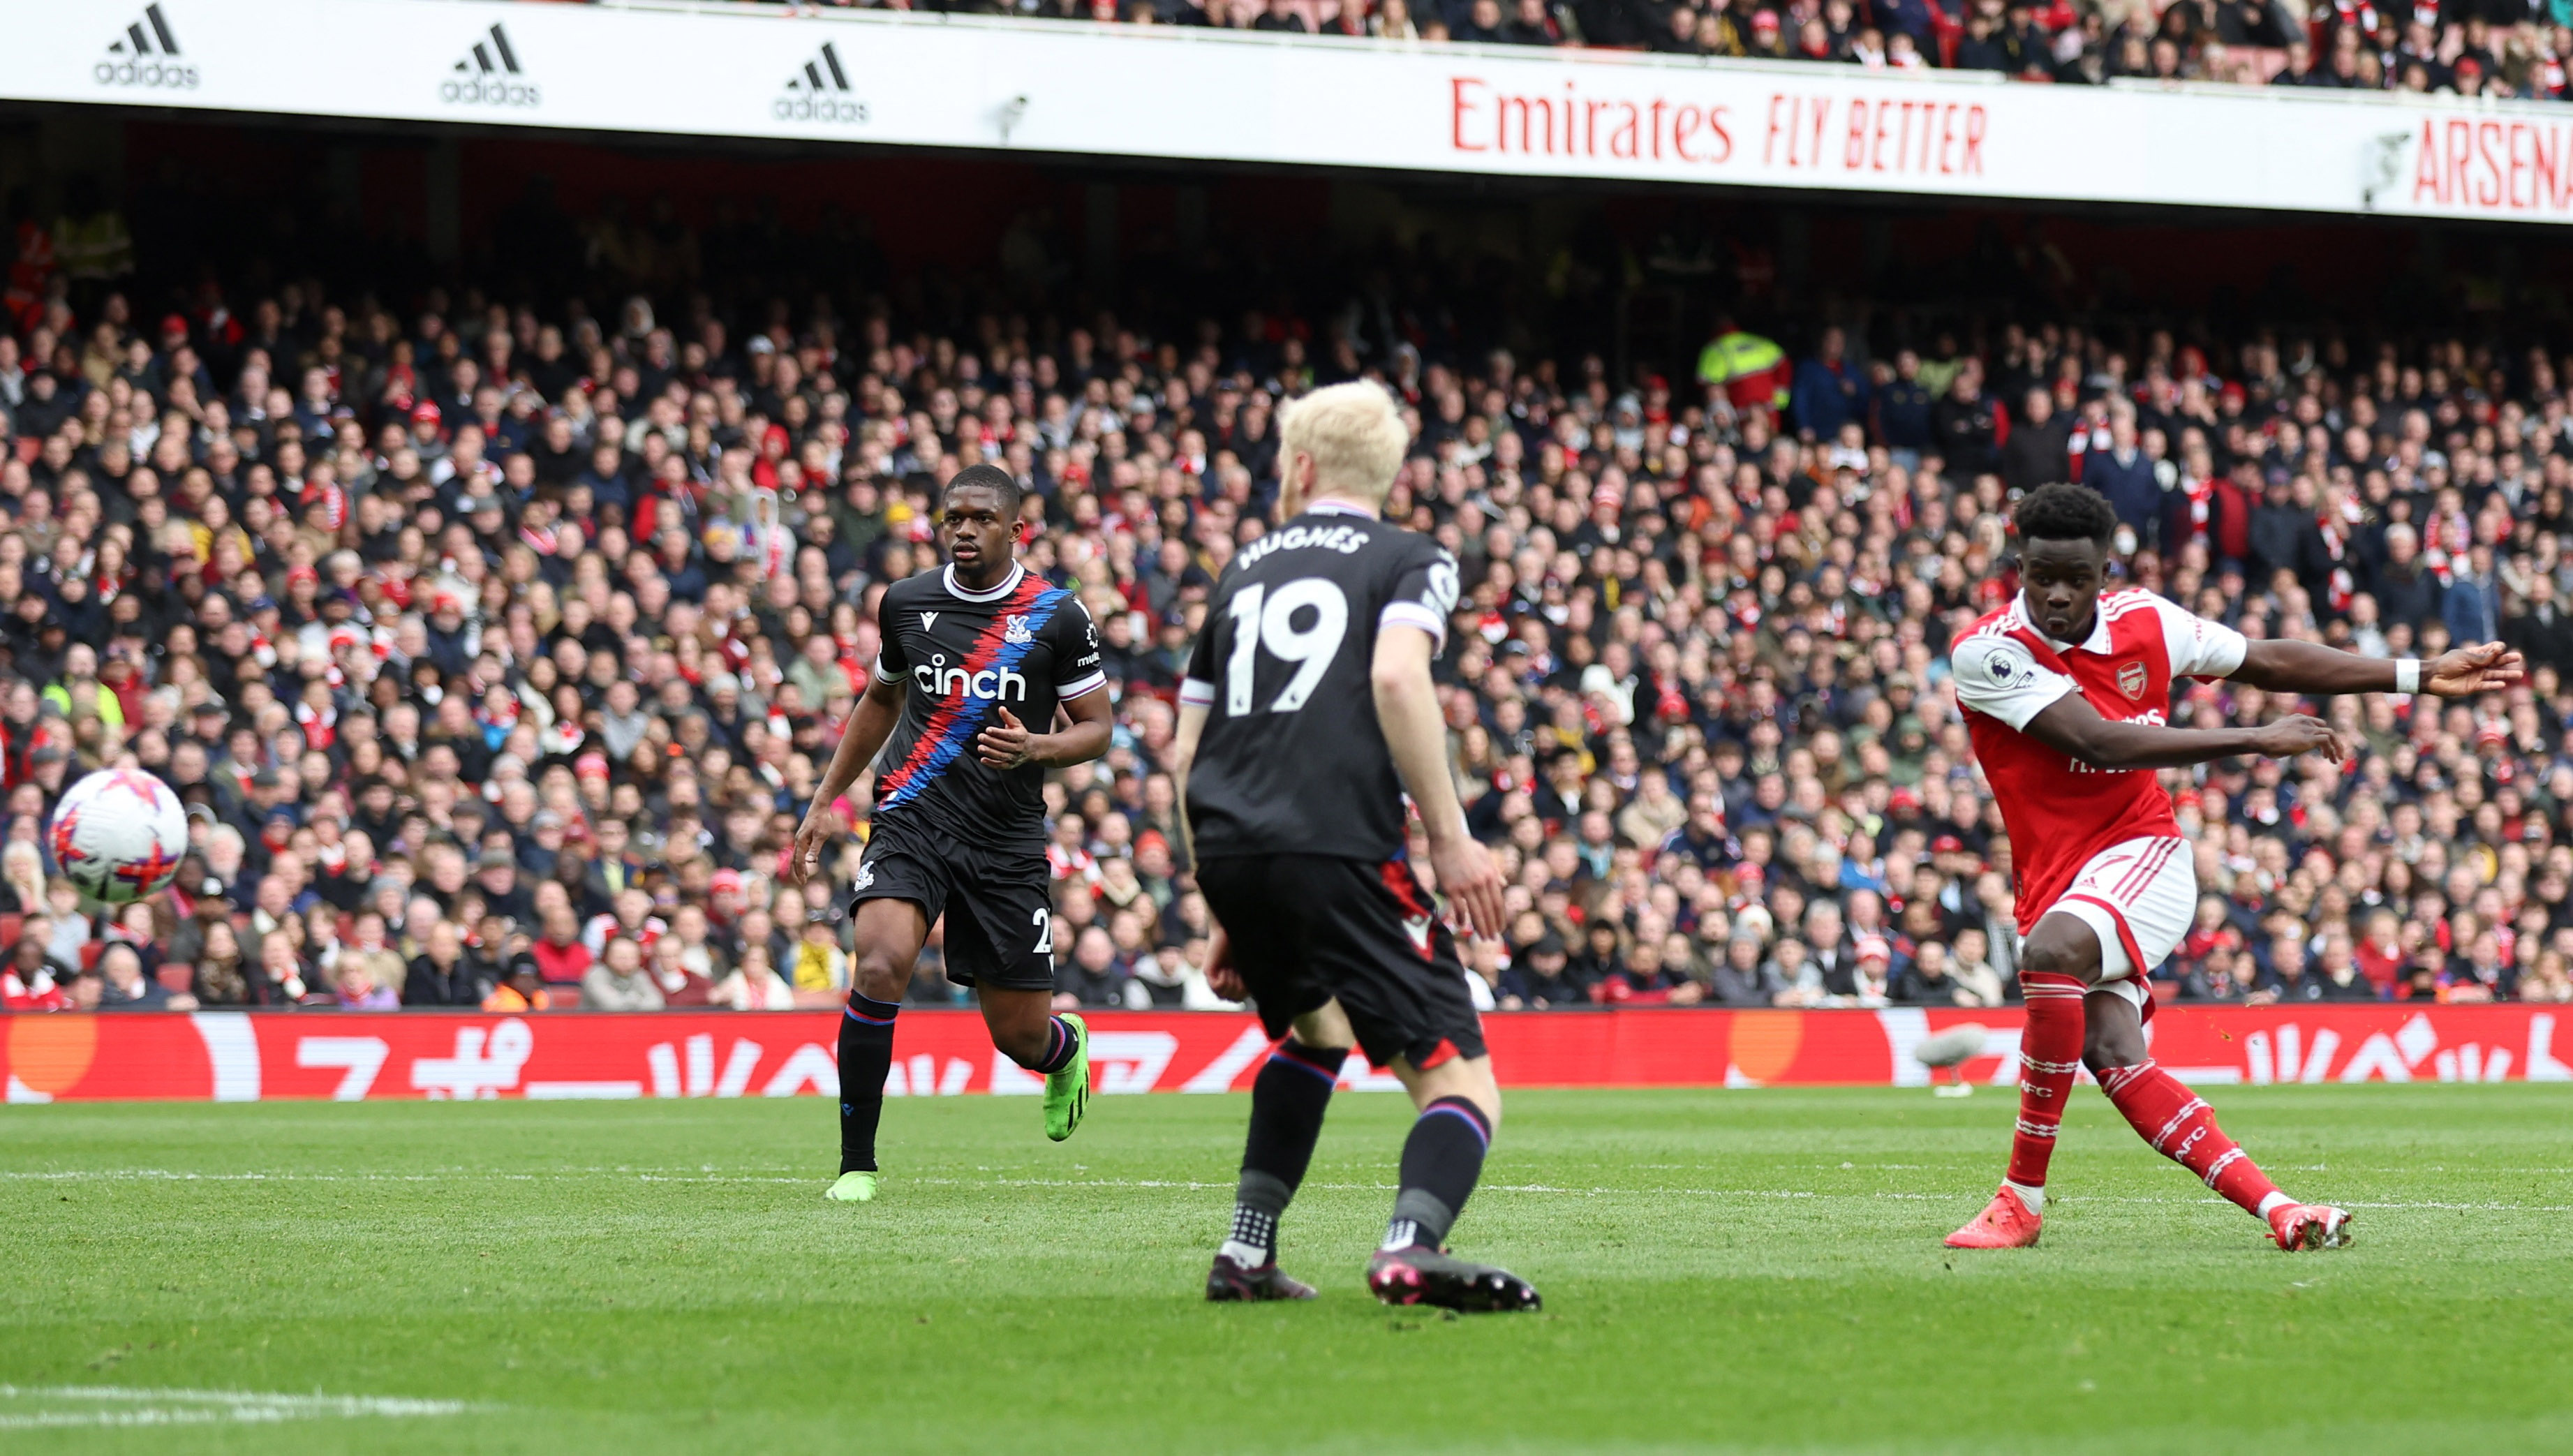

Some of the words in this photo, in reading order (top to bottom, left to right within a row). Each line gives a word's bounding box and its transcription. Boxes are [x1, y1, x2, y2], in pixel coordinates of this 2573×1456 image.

[95, 59, 199, 89] adidas
[440, 76, 542, 105] adidas
[773, 94, 870, 123] adidas
[1450, 77, 1735, 165] Emirates
[1763, 94, 1832, 168] FLY
[1844, 98, 1987, 177] BETTER
[1238, 525, 1370, 571] HUGHES
[1226, 577, 1349, 717] 19
[914, 653, 1026, 701] cinch
[2021, 1079, 2053, 1099] AFC
[2176, 1126, 2208, 1164] AFC
